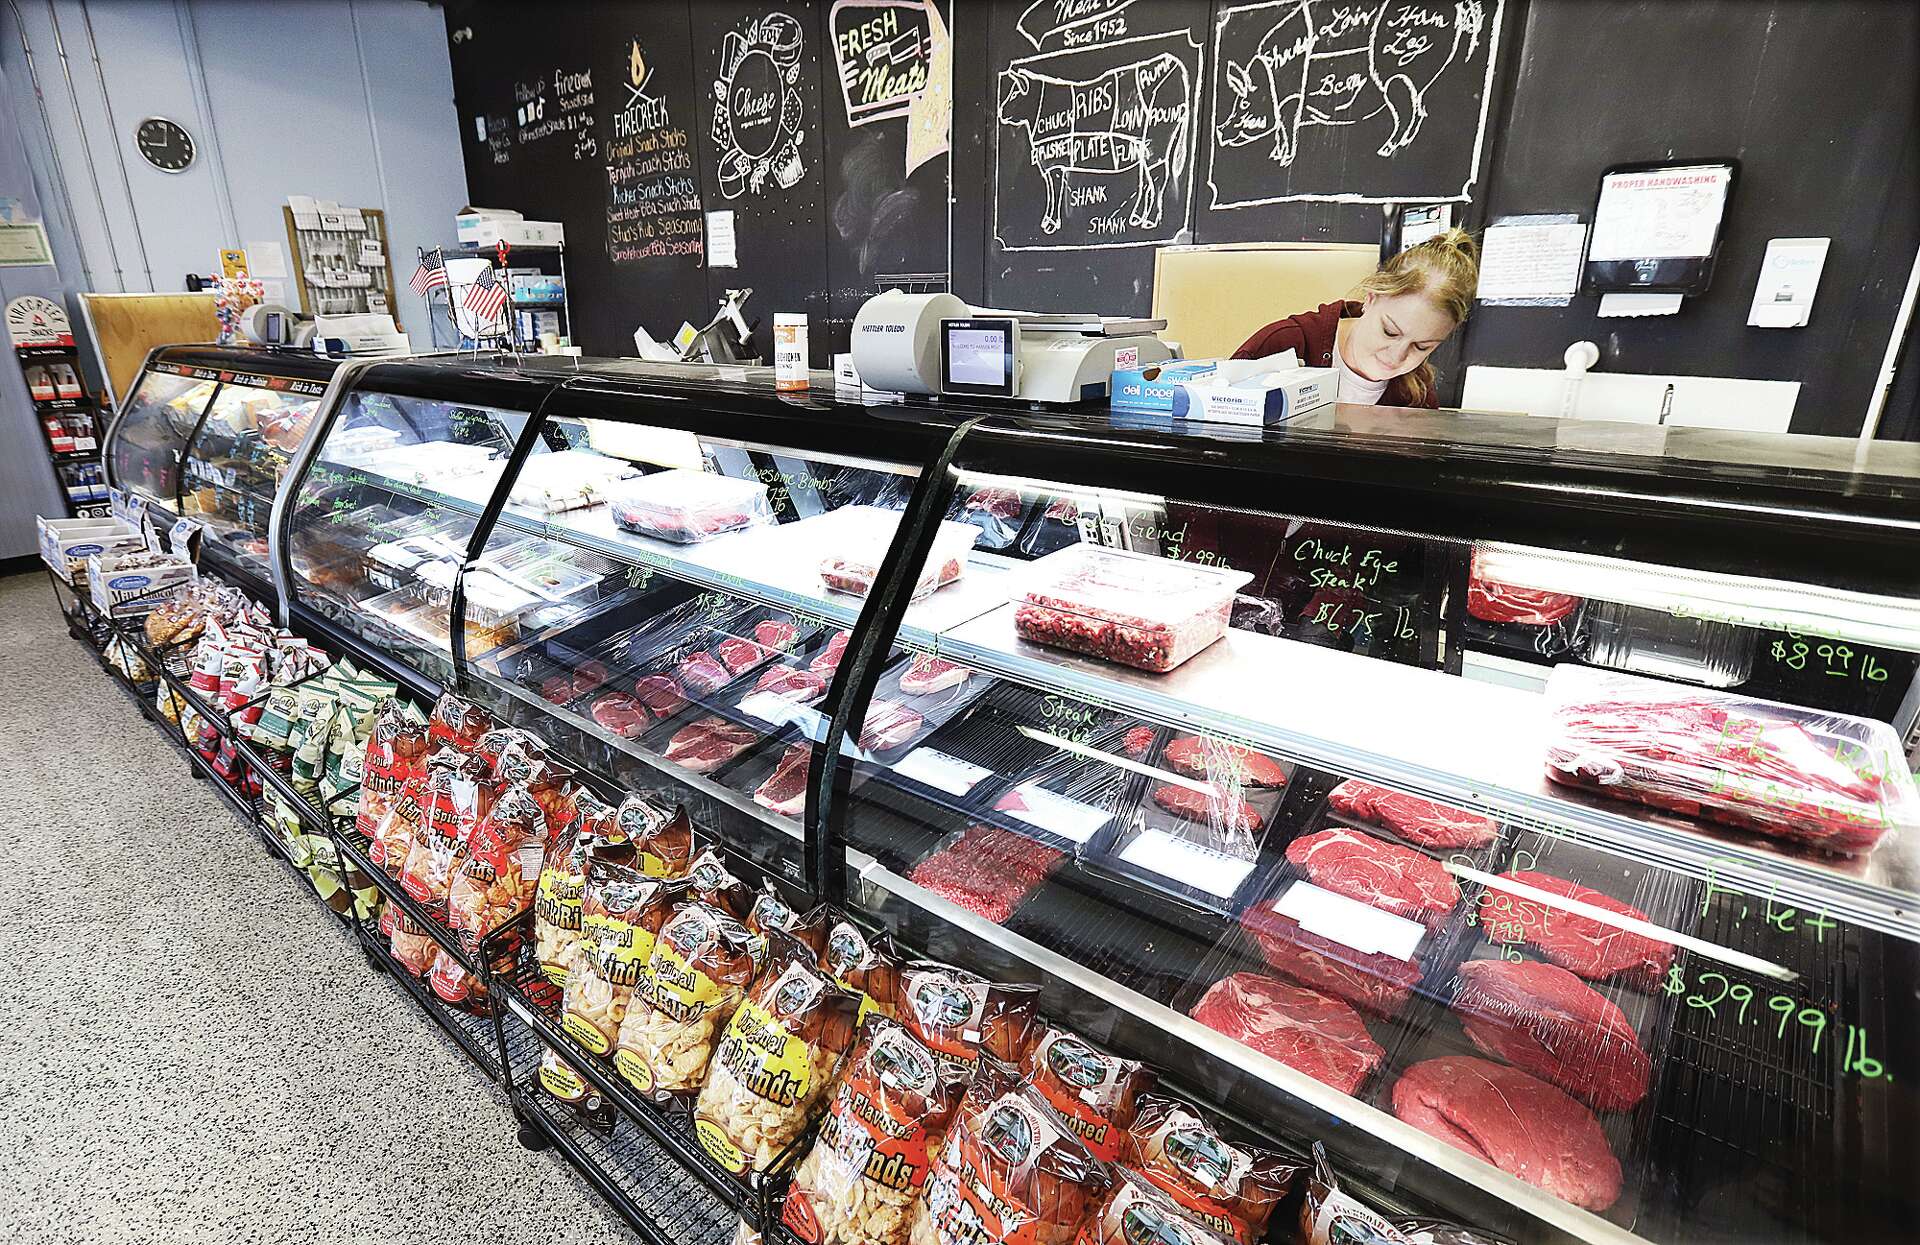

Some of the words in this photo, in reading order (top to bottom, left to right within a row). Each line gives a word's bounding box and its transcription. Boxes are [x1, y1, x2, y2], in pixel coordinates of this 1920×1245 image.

[838, 8, 898, 62] FRESH
[1063, 29, 1092, 47] Since
[1093, 18, 1128, 41] 1952
[1382, 28, 1434, 67] Leg
[858, 59, 928, 103] Meats
[1139, 57, 1174, 90] RUMP
[734, 86, 776, 118] Cheese
[1075, 81, 1114, 120] RIBS
[1148, 102, 1189, 126] ROUND
[614, 95, 670, 138] FIRECREEK
[1037, 110, 1074, 135] CHUCK
[1114, 105, 1144, 131] LOIN
[1073, 136, 1110, 162] PLATE
[1069, 185, 1108, 207] SHANK
[657, 217, 703, 242] Seasoning
[1087, 216, 1127, 234] SHANK
[1144, 386, 1174, 401] pape
[742, 463, 796, 487] Awesome
[1293, 539, 1351, 565] Chuck
[1360, 549, 1399, 586] Eye
[1309, 568, 1366, 591] Steak
[1860, 653, 1889, 682] lb
[1039, 694, 1095, 727] Steak
[1662, 962, 1828, 1054] $29.99
